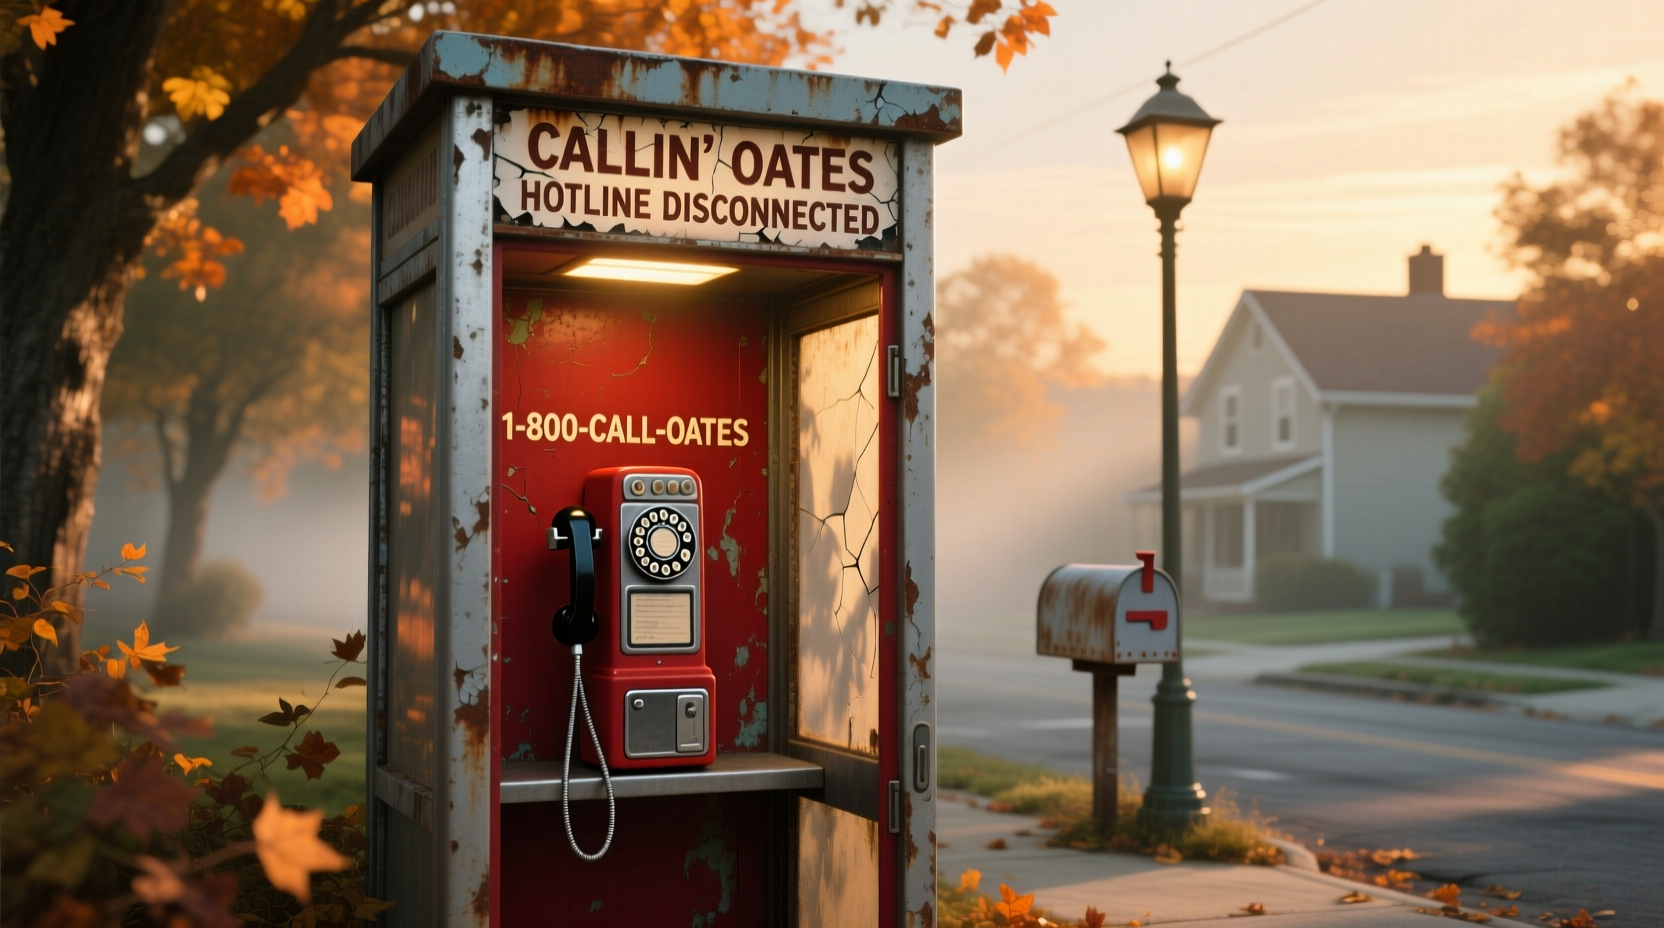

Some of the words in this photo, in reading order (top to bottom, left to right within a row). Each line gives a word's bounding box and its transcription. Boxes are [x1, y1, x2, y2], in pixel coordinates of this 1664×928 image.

[527, 122, 714, 182] CALLIN’
[731, 140, 875, 195] OATES
[520, 180, 652, 220] HOTLINE
[662, 190, 880, 236] DISCONNECTED
[501, 411, 750, 447] 1-800-CALL-OATES
